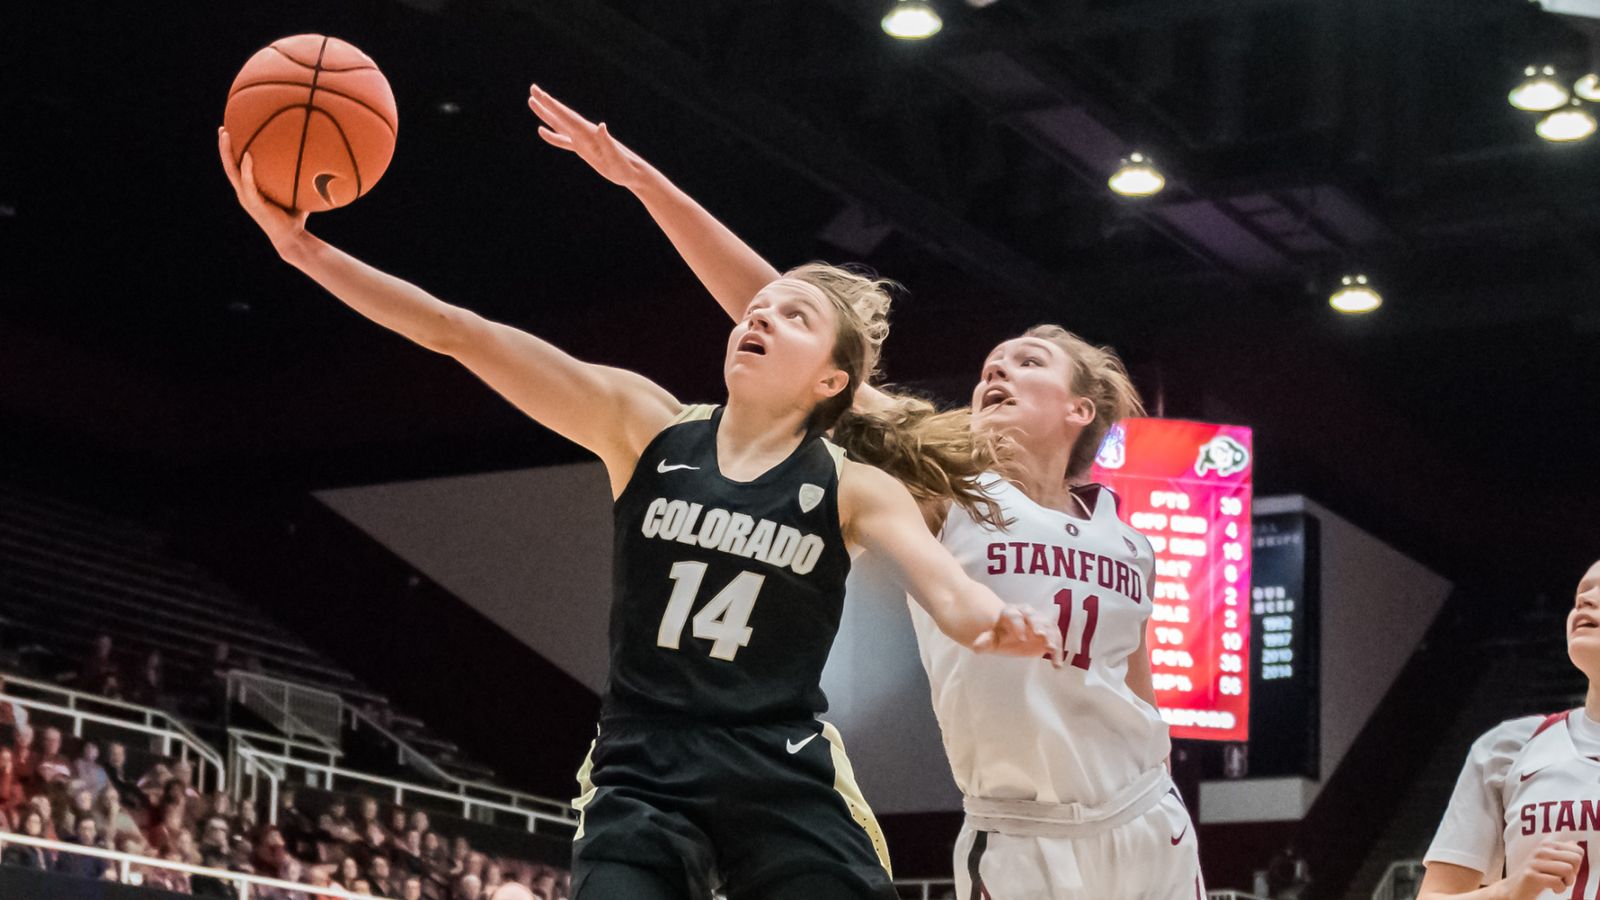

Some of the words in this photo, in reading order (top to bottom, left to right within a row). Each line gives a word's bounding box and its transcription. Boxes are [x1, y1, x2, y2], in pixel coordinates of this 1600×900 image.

[641, 497, 825, 575] COLORADO
[987, 541, 1142, 605] STANFORD
[1224, 586, 1238, 606] 2
[657, 560, 766, 662] 14
[1042, 588, 1099, 671] 11
[1224, 609, 1238, 628] 2
[1520, 800, 1600, 836] STAN
